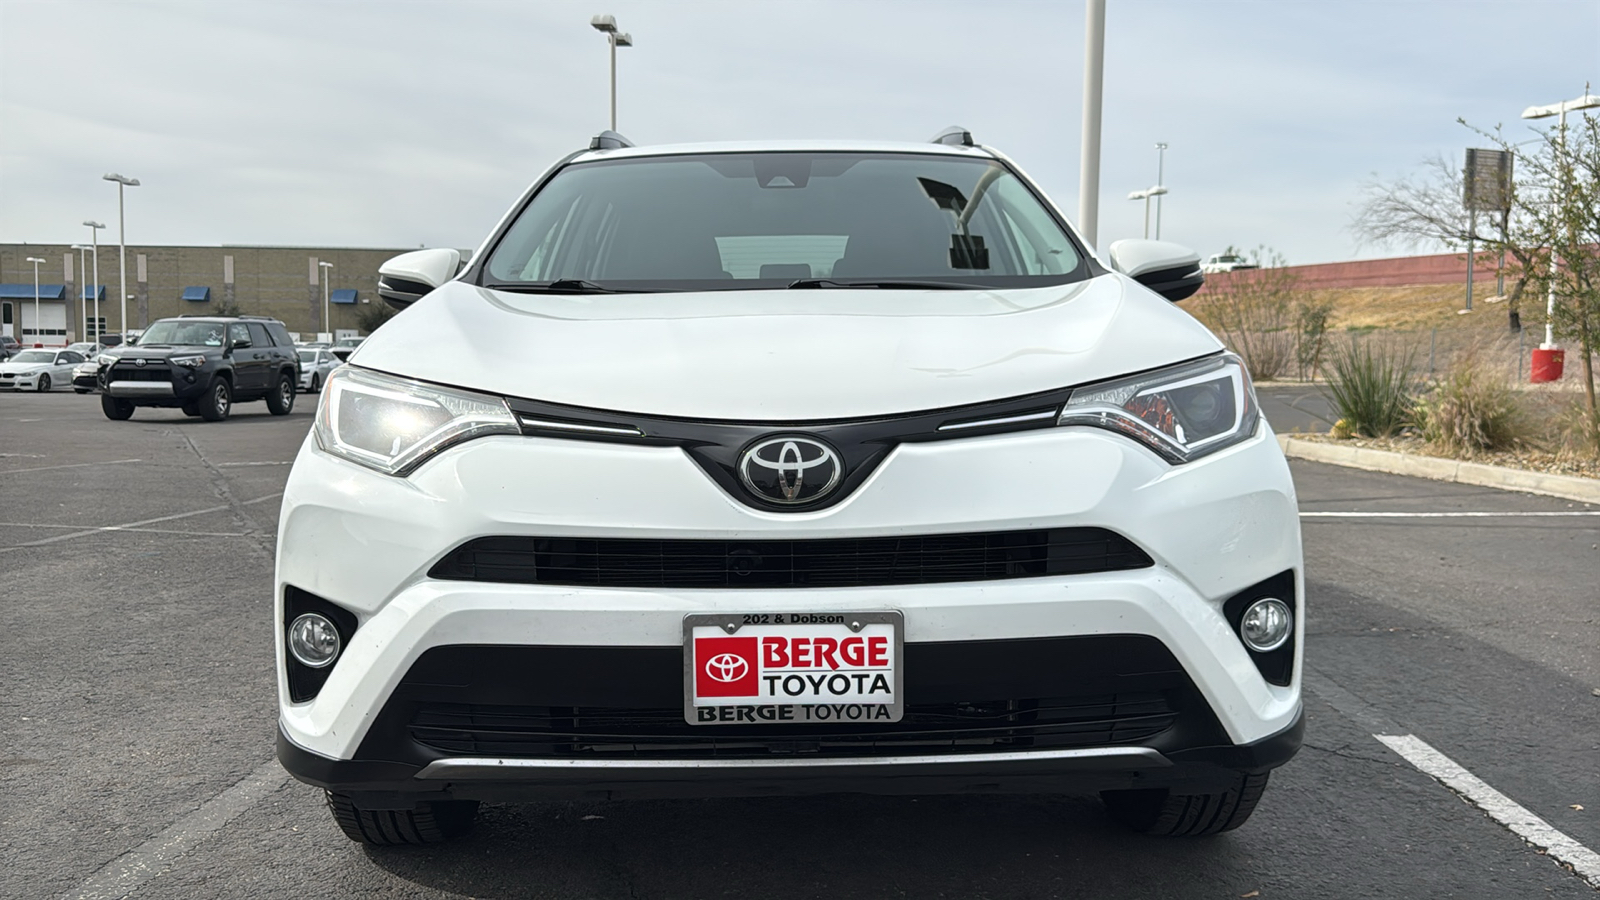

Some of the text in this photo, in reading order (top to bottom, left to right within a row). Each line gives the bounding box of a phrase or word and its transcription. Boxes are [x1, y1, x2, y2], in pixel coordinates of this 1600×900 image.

[743, 613, 844, 624] 202 & Dobson
[762, 636, 889, 671] BERGE
[762, 673, 891, 696] TOYOTA
[697, 704, 891, 722] BERGE TOYOTA
